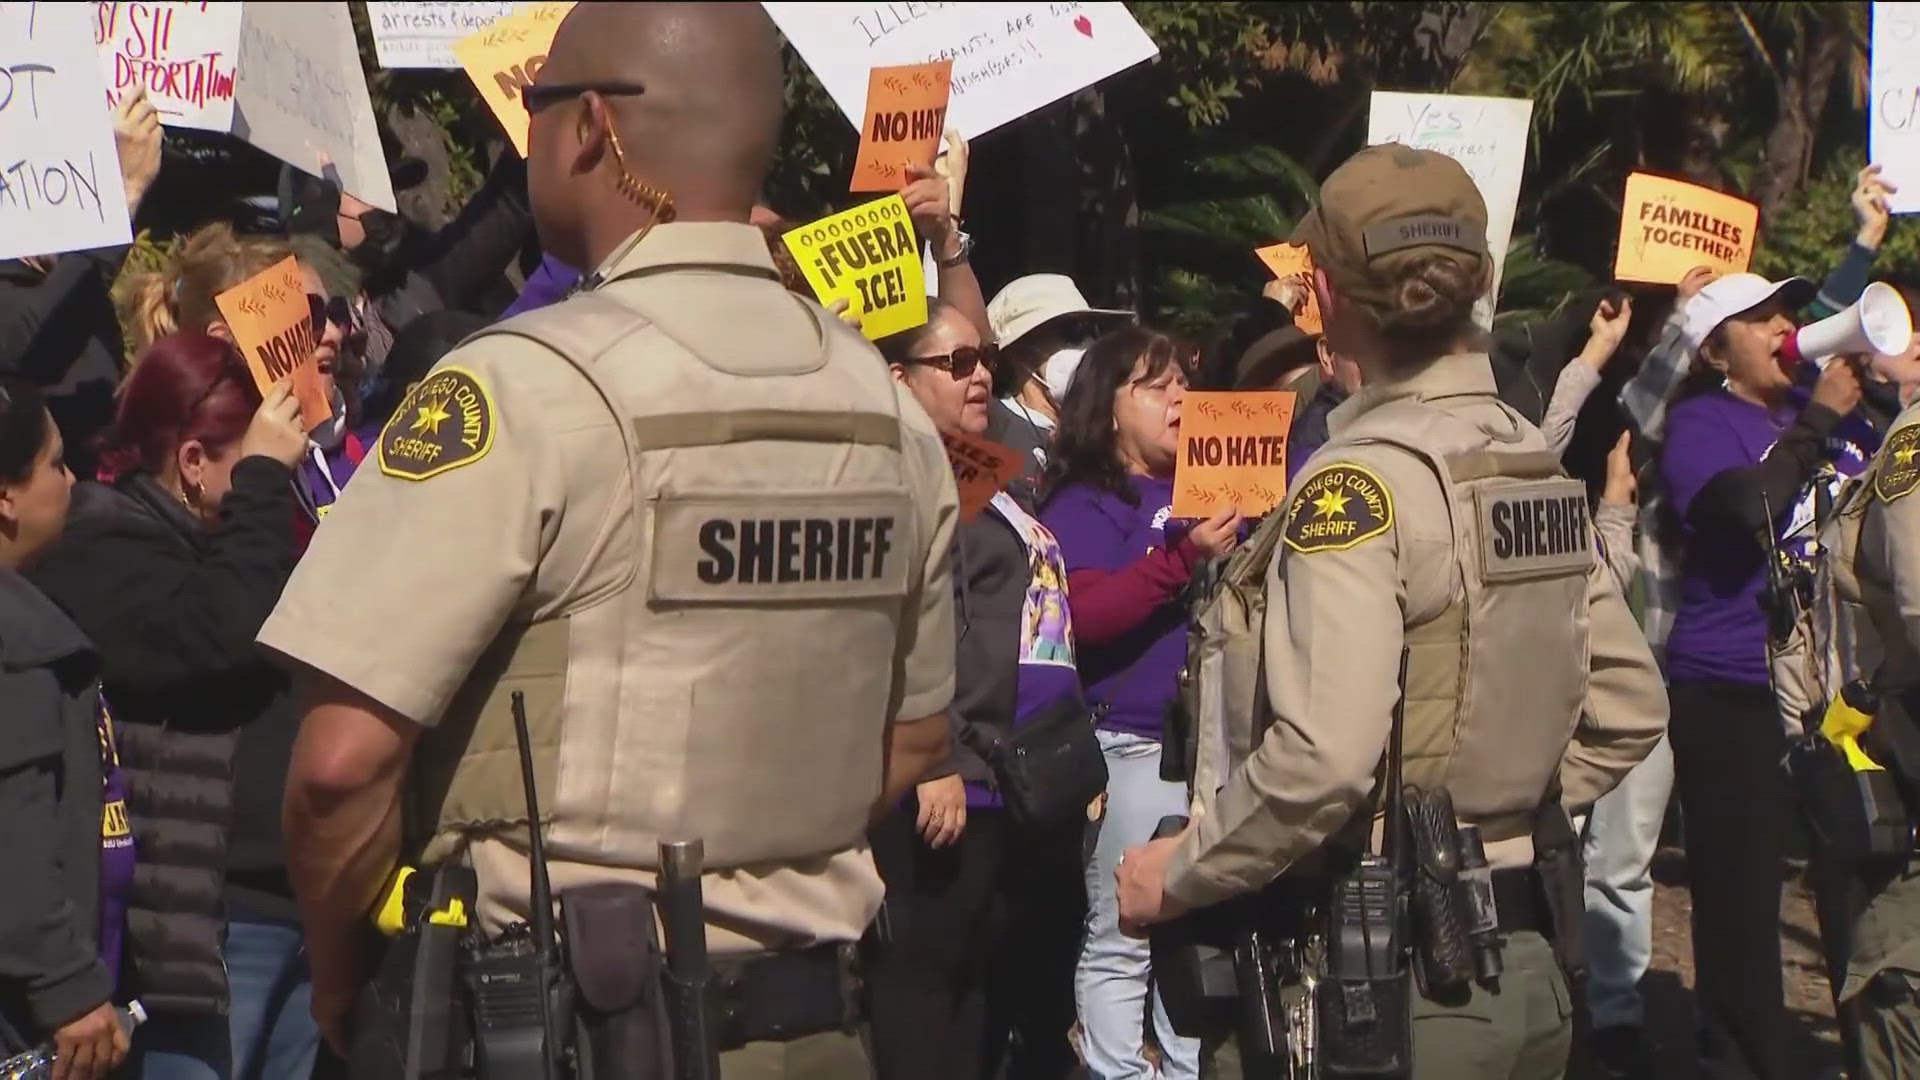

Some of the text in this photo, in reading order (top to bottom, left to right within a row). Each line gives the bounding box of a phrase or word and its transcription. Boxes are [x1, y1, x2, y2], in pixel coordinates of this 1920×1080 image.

[382, 11, 446, 30] arrests
[872, 111, 908, 142] NO
[1400, 222, 1459, 239] SHERIFF
[1640, 201, 1742, 245] FAMILIES
[1643, 226, 1734, 263] TOGETHER
[815, 221, 914, 289] ¡FUERA
[855, 266, 906, 314] ICE!
[256, 335, 292, 383] NO
[455, 385, 482, 450] COUNTY
[389, 436, 442, 463] SHERIFF
[1188, 436, 1284, 467] NO HATE
[1305, 473, 1344, 498] DIEGO
[1346, 475, 1384, 521] COUNTY
[1300, 521, 1358, 541] SHERIFF
[1491, 496, 1589, 560] SHERIFF
[697, 517, 894, 584] SHERIFF
